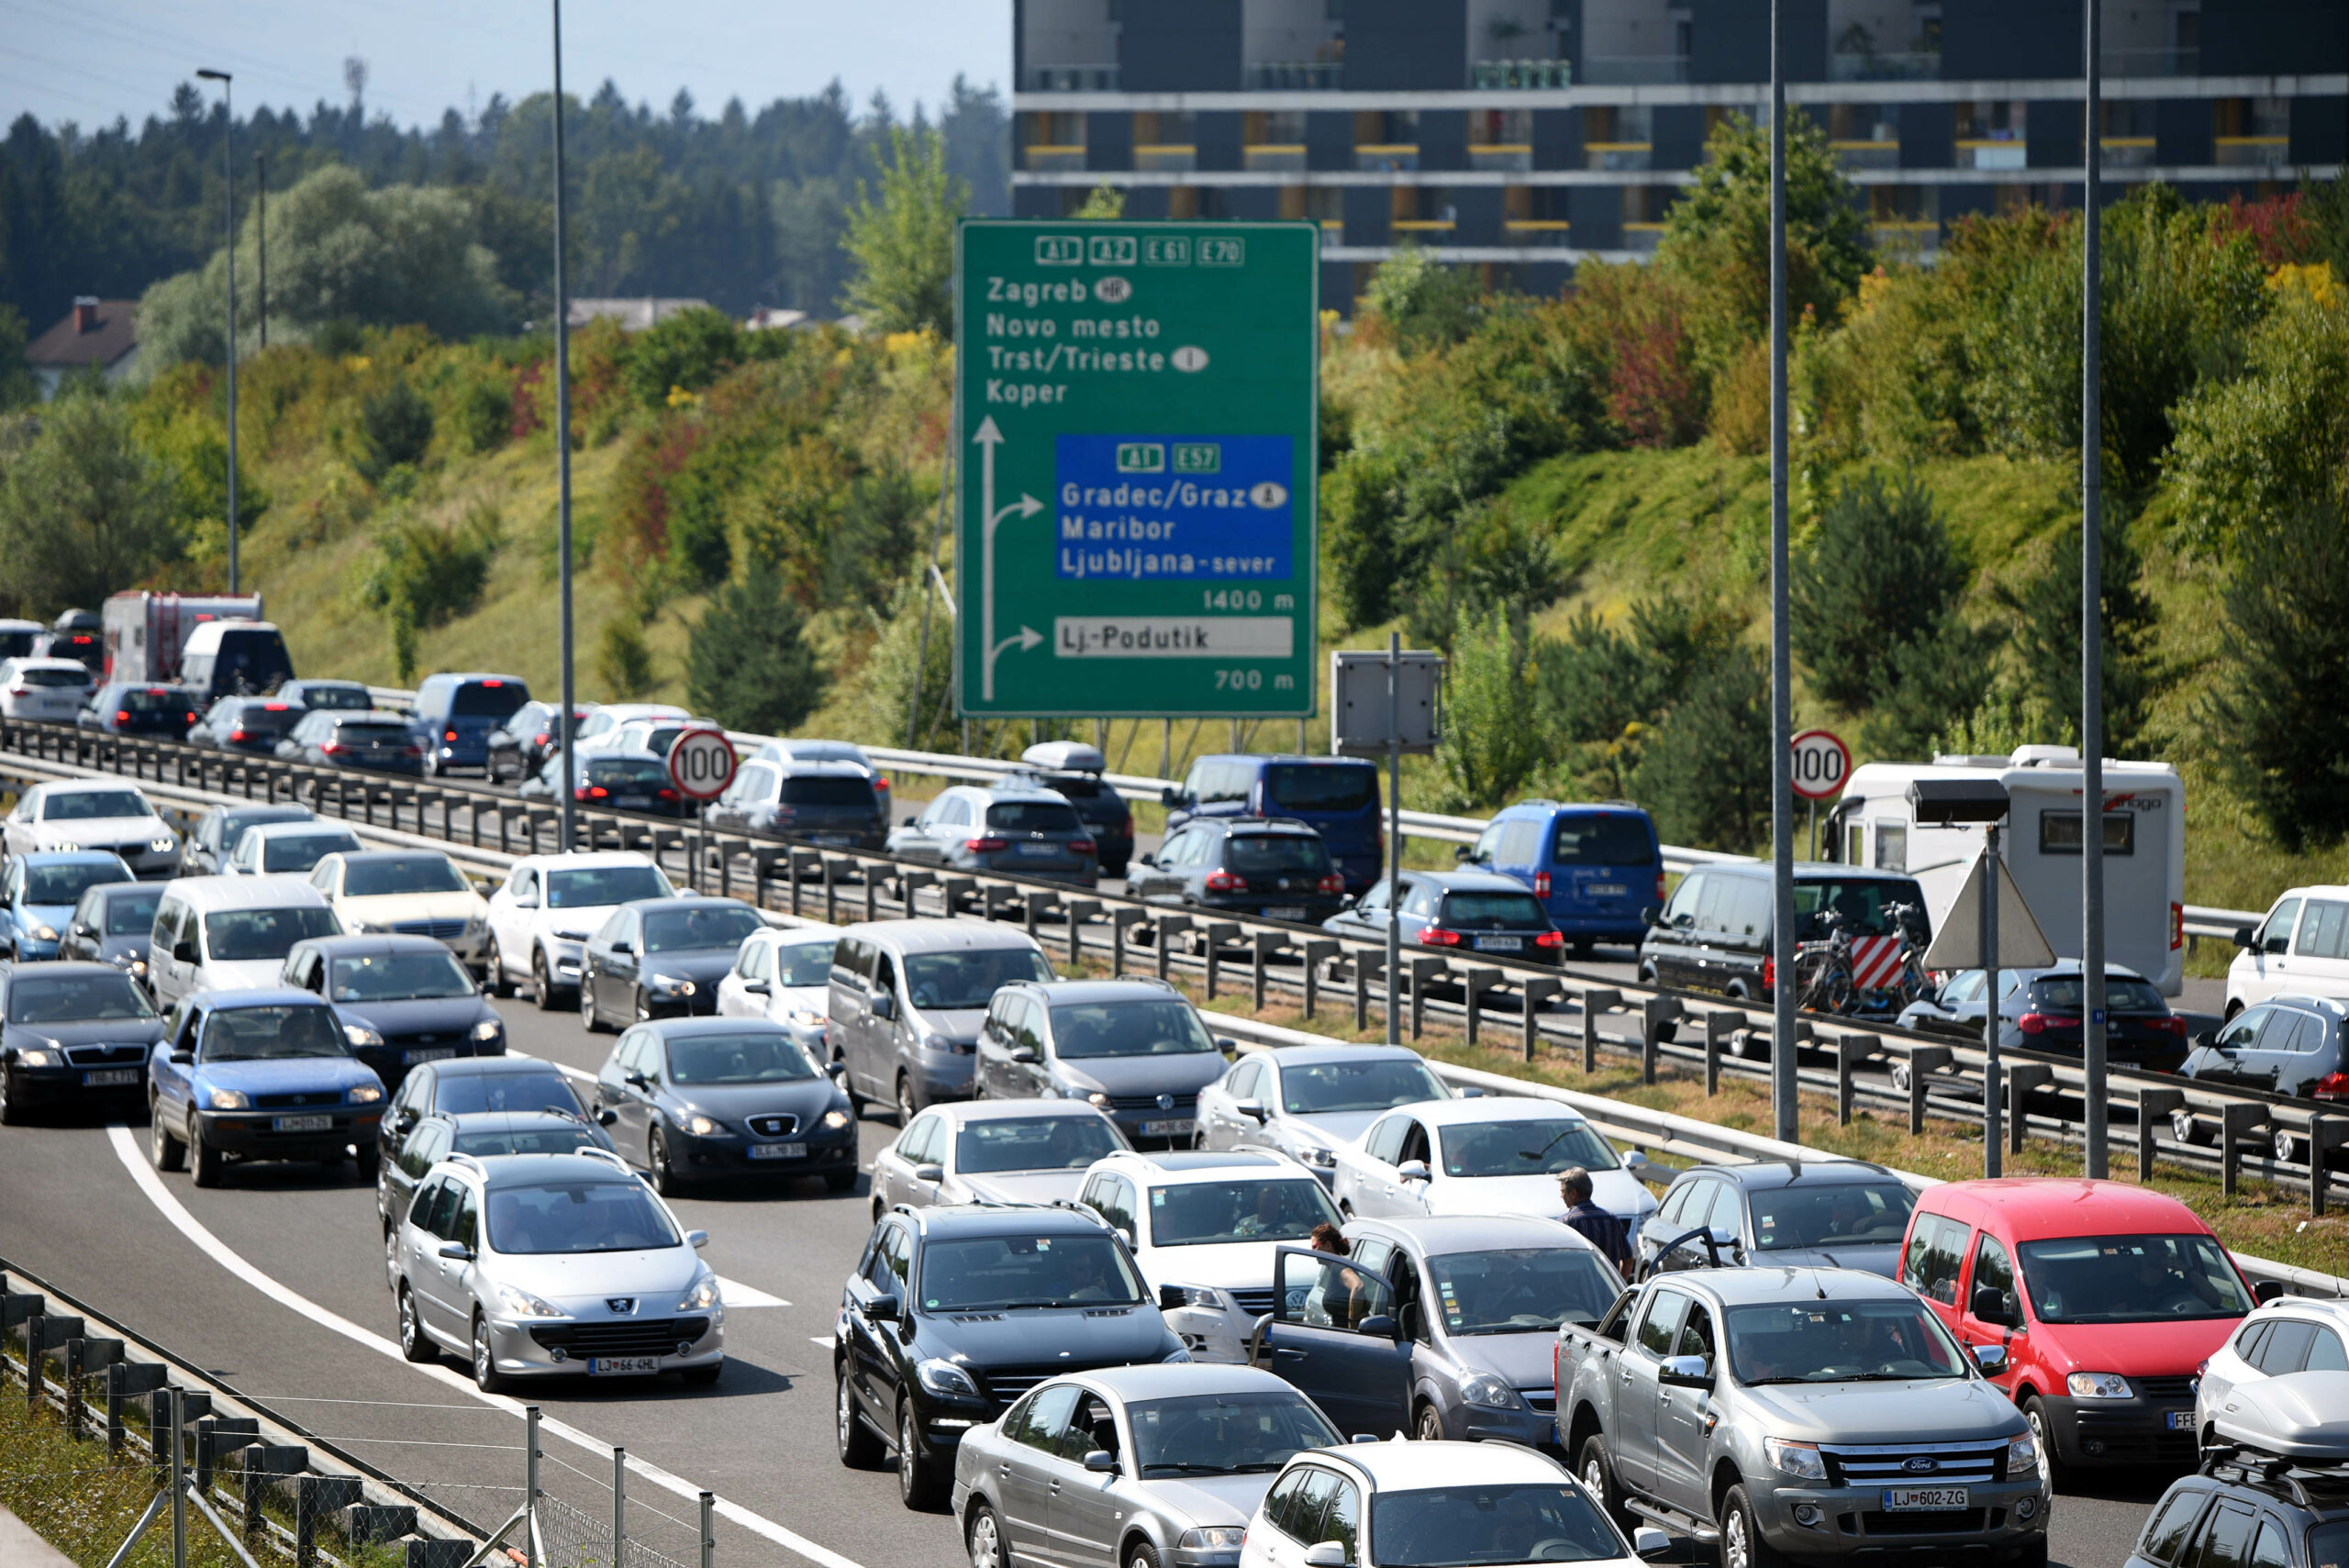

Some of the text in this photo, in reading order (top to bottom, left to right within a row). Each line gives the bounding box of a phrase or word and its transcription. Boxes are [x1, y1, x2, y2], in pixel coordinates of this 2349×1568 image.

[987, 277, 1086, 307] Zagreb
[986, 313, 1161, 338] Novo mesto
[987, 344, 1164, 373] Trst/Trieste
[986, 379, 1067, 407] Koper
[1062, 480, 1246, 509] Gradec/Graz
[1062, 516, 1175, 539] Maribor
[1204, 590, 1295, 610] 1400 m
[1215, 670, 1295, 690] 700 m
[681, 746, 729, 782] 100
[1793, 747, 1842, 782] 100
[597, 1361, 612, 1372] LJ
[1910, 1459, 1932, 1470] Ford
[1894, 1491, 1965, 1507] LJ 602-ZG
